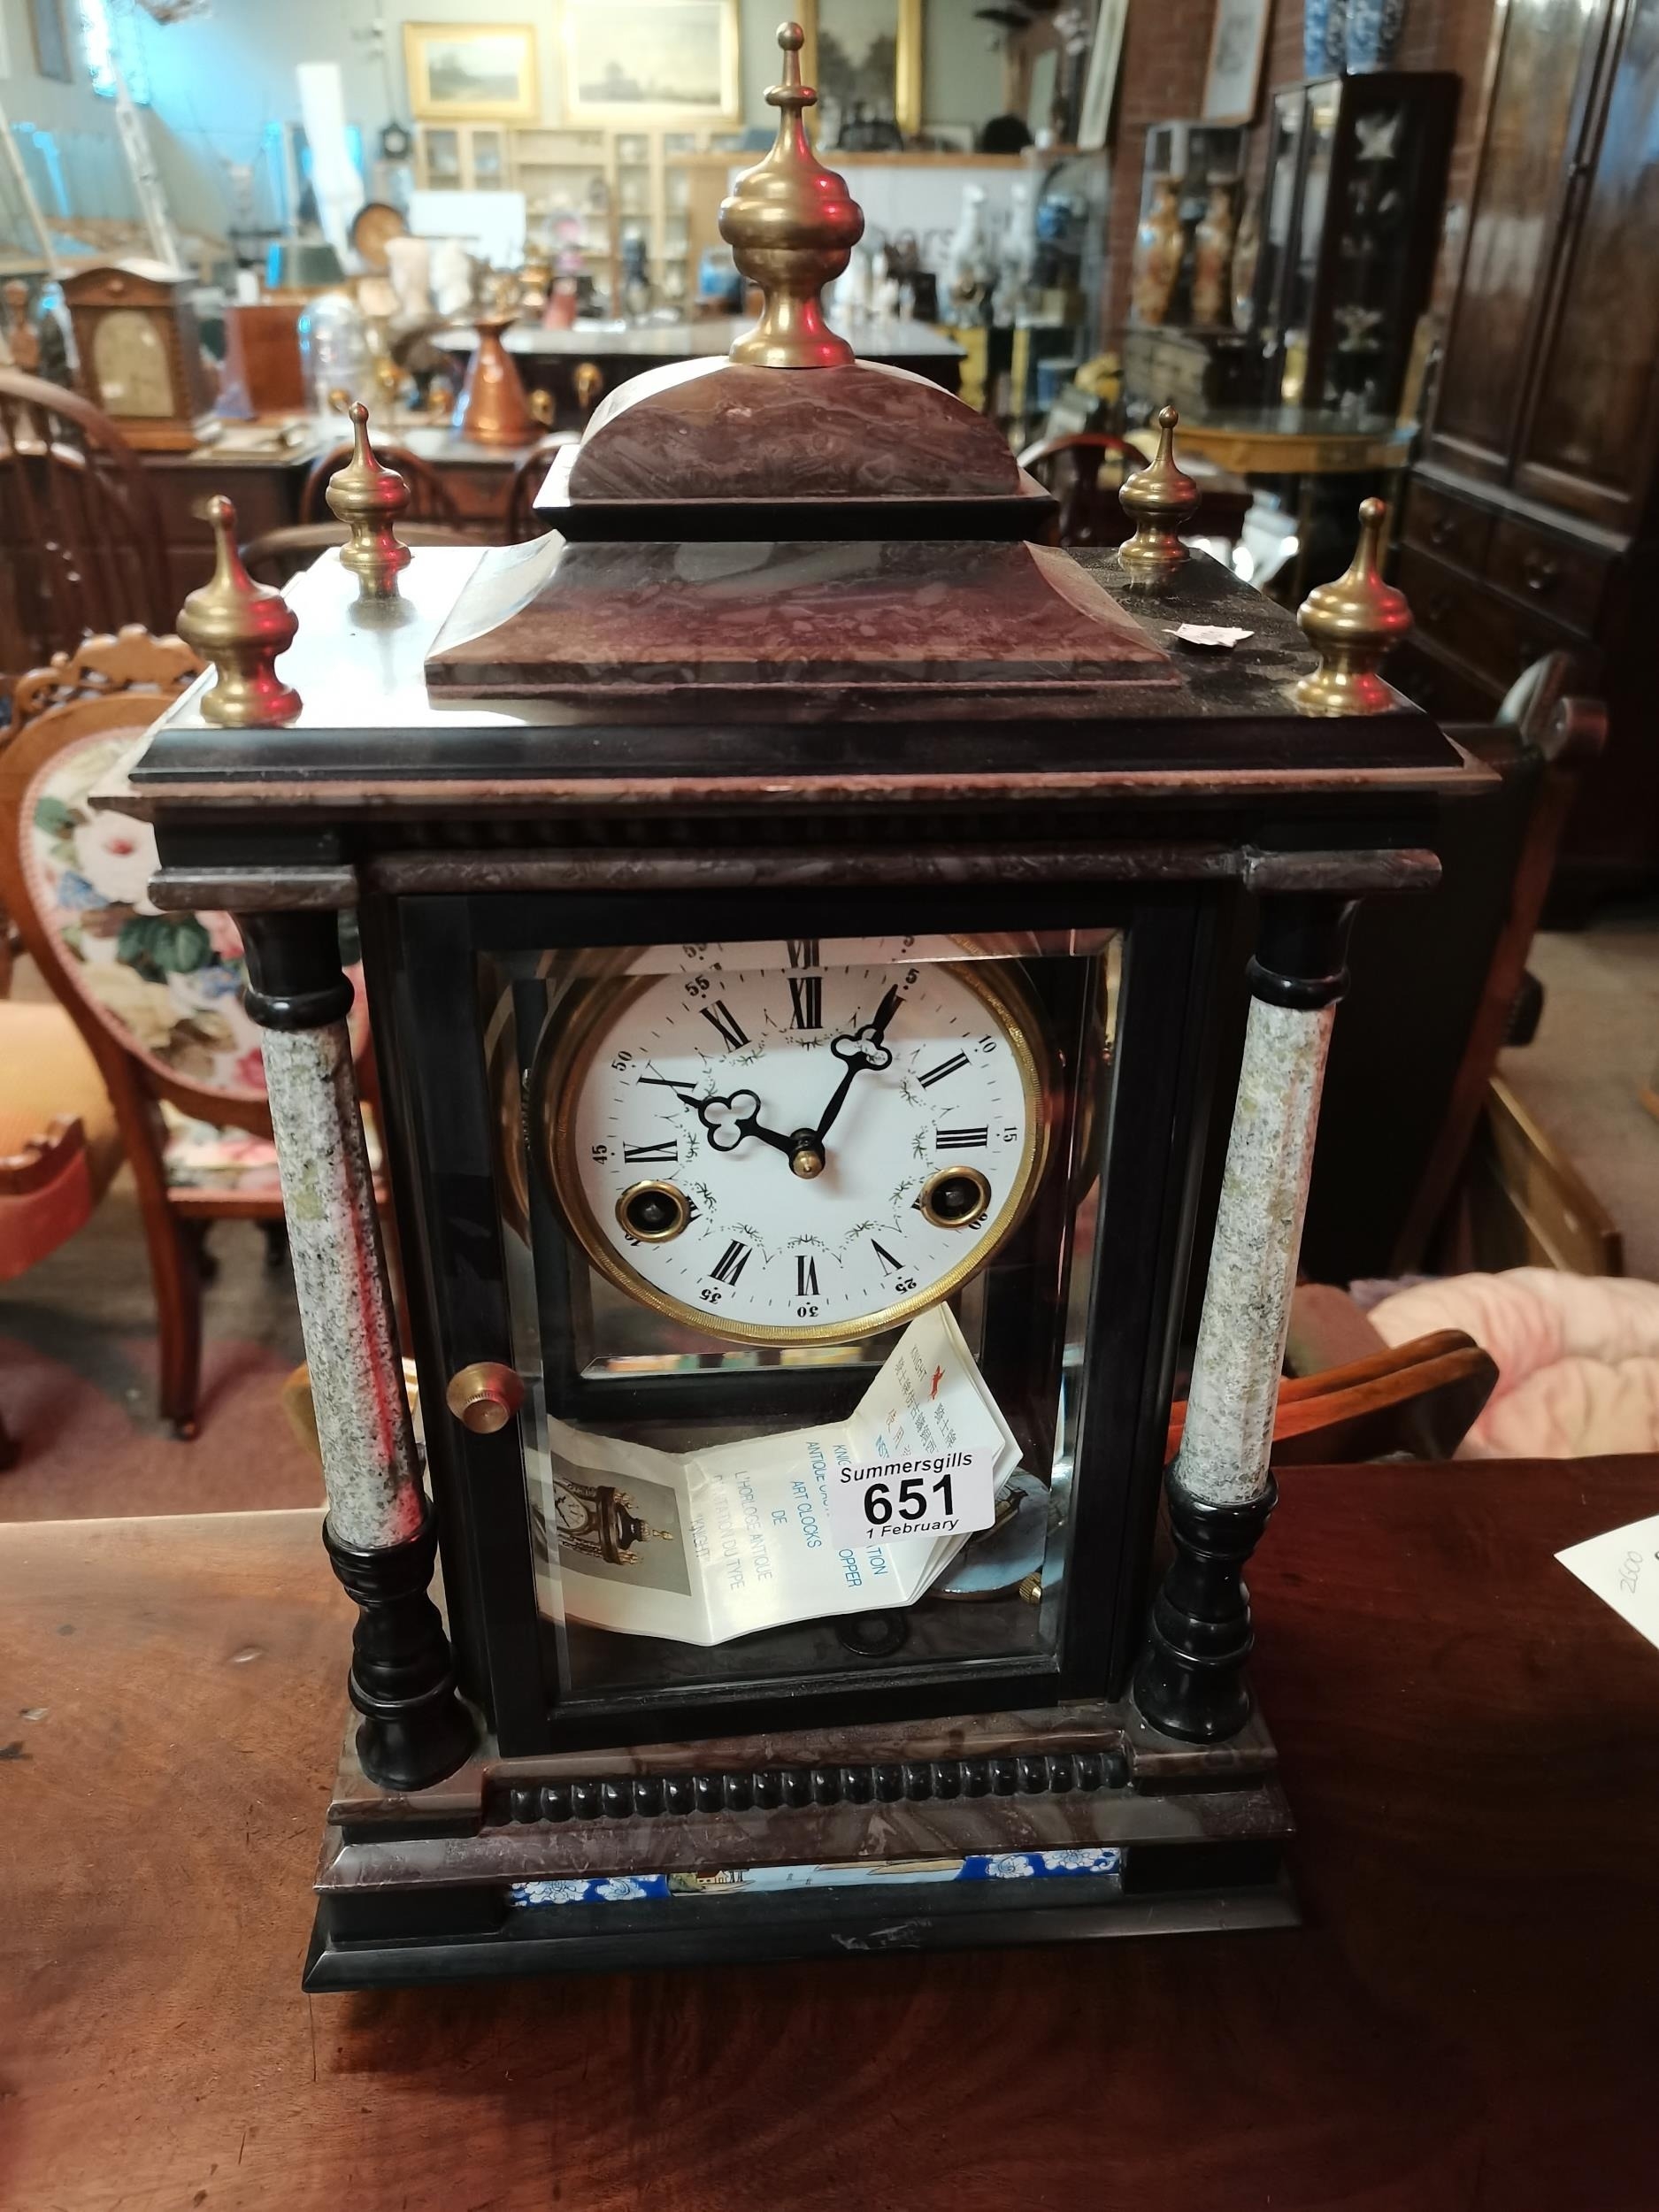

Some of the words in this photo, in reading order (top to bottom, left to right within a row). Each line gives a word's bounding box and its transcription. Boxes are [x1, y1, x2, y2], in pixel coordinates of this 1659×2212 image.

[685, 974, 710, 996] 55
[787, 977, 824, 1030] XII
[699, 1000, 752, 1053] XI
[978, 1033, 997, 1053] 10
[611, 1050, 633, 1071] 50
[916, 1048, 972, 1090] II
[636, 1060, 698, 1102] X
[935, 1124, 989, 1151] III
[1002, 1126, 1018, 1142] 15
[592, 1144, 608, 1165] 45
[623, 1139, 679, 1164] IX
[707, 1239, 753, 1286] VII
[871, 1238, 906, 1277] V
[795, 1255, 821, 1297] VI
[895, 1277, 918, 1294] 25
[699, 1288, 722, 1305] 35
[796, 1305, 819, 1318] 30
[840, 1452, 973, 1484] Summersgills
[790, 1481, 810, 1500] ART
[864, 1473, 954, 1525] 651
[771, 1509, 787, 1525] DE
[796, 1502, 822, 1549] CLOCKS
[866, 1528, 874, 1540] 1
[880, 1518, 959, 1538] February
[721, 1538, 740, 1557] DU
[749, 1533, 772, 1581] ANTIQUE
[726, 1558, 745, 1591] TYPE
